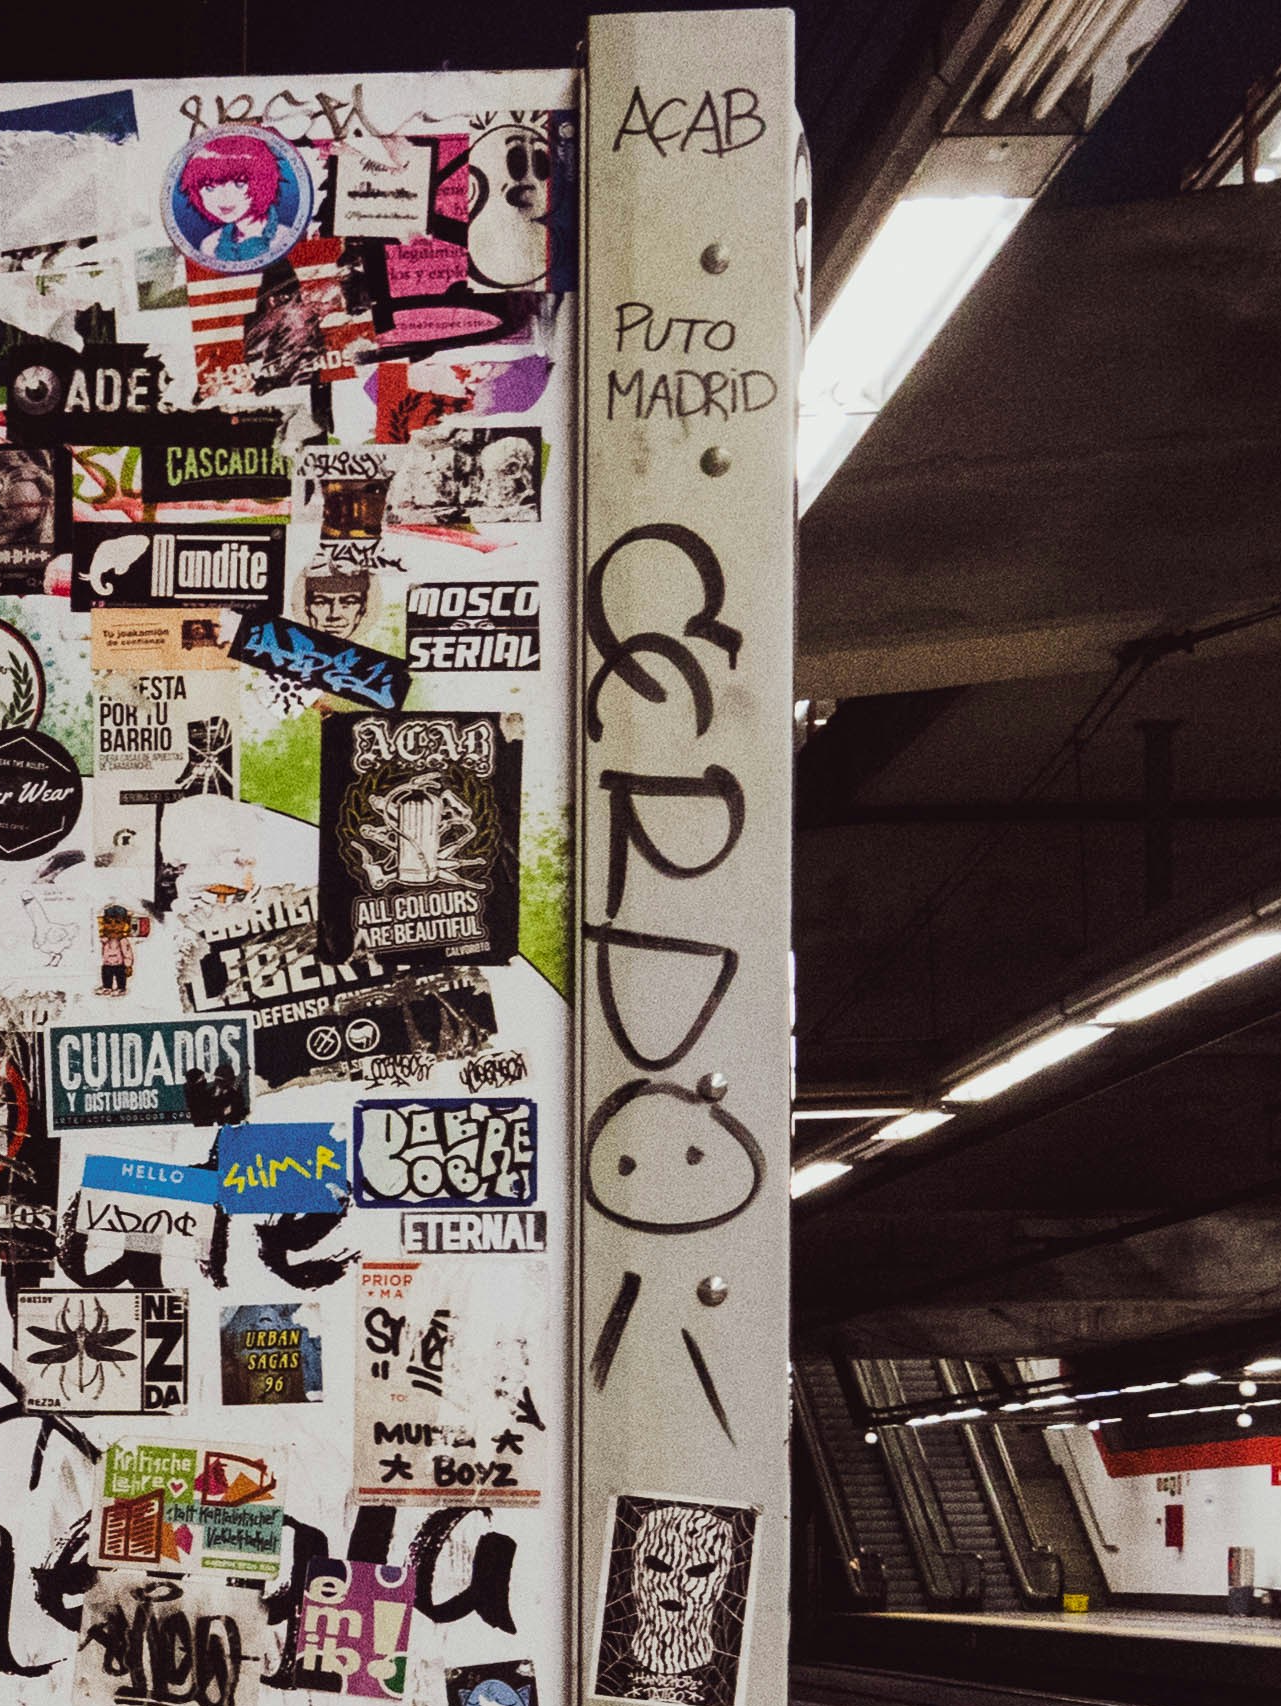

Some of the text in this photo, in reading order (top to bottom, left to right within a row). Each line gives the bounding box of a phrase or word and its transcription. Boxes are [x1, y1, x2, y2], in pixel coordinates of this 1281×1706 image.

[613, 86, 766, 159] ACAB
[615, 302, 735, 352] PUTO
[151, 534, 268, 598] Mandite
[408, 585, 539, 617] MOSCO
[408, 632, 541, 670] SERIAL
[100, 702, 138, 727] POR
[100, 727, 172, 753] BARRIO
[19, 780, 75, 804] Wear
[359, 890, 480, 926] ALL COLOURS
[391, 916, 483, 947] BEAUTIFUL
[58, 1024, 242, 1091] CUIDADOS
[67, 1088, 159, 1114] Y DISTURBIOS
[121, 1163, 185, 1184] HELLO
[404, 1213, 546, 1252] ETERNAL
[246, 1329, 301, 1348] URBAN
[247, 1352, 299, 1371] SAGAS
[265, 1375, 284, 1393] 96
